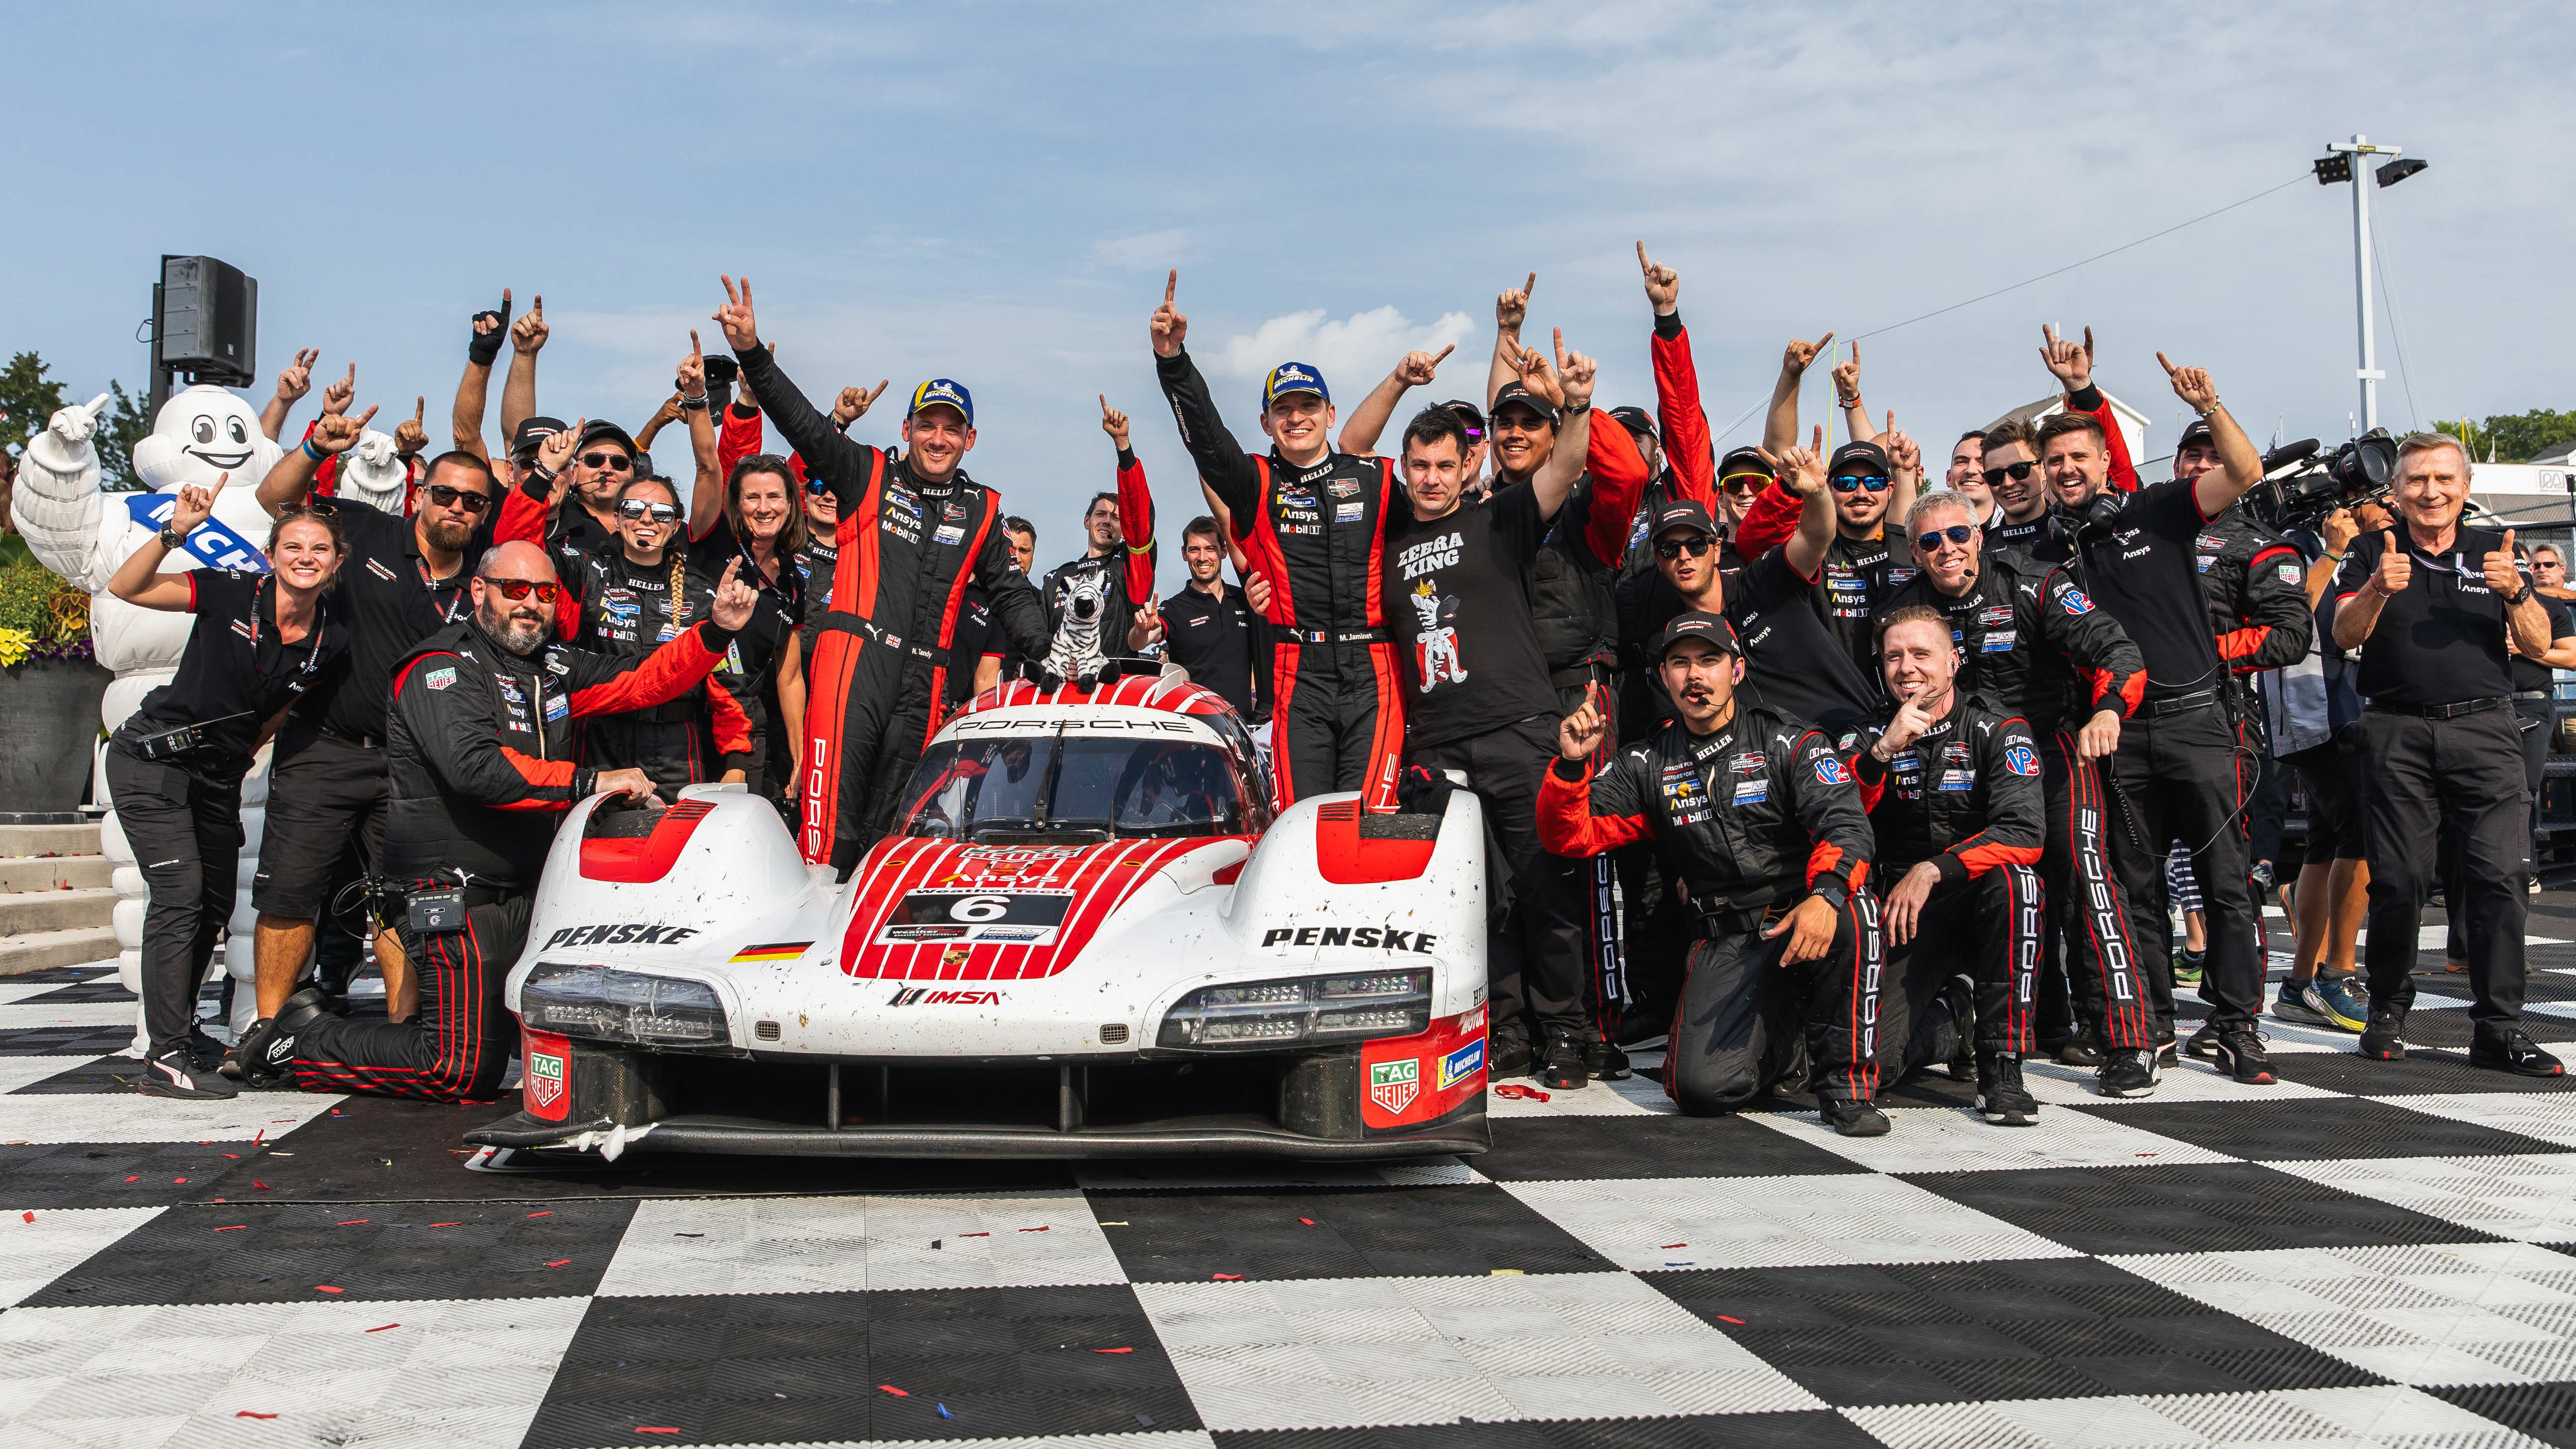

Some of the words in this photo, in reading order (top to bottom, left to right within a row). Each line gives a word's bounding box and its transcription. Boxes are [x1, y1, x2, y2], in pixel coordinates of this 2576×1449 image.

[1274, 376, 1314, 389] MICHELIN
[924, 392, 963, 404] MICHELIN
[1301, 463, 1333, 484] HELLER
[885, 506, 922, 530] Ansys
[1281, 508, 1319, 522] Ansys
[1663, 509, 1679, 517] PORSCHE
[1663, 513, 1687, 522] MOTORSPORT
[882, 520, 909, 539] Mobil
[1280, 523, 1308, 534] Mobil
[1309, 525, 1319, 535] 1
[2002, 526, 2036, 537] HELLER
[1397, 532, 1464, 568] ZEBRA
[2123, 545, 2150, 560] Ansys
[1404, 549, 1459, 581] KING
[1857, 551, 1889, 566] HELLER
[628, 578, 665, 591] HELLER
[2462, 585, 2489, 594] Ansys
[1832, 592, 1866, 605] Ansys
[1949, 594, 1984, 611] HELLER
[2061, 591, 2087, 614] VP
[971, 614, 986, 626] Ansys
[1742, 611, 1758, 627] BOSS
[1833, 608, 1857, 617] Mobil
[1858, 608, 1868, 617] 1
[598, 627, 625, 639] Mobil
[1749, 626, 1771, 647] Ansys
[732, 648, 737, 659] 6
[918, 648, 932, 659] Tandy
[428, 669, 452, 680] TAG
[549, 665, 562, 673] PUMA
[429, 677, 455, 688] HEUER
[509, 720, 527, 733] Mobil
[953, 719, 1194, 735] PORSCHE
[1696, 734, 1733, 761] HELLER
[2005, 747, 2032, 775] VP
[1663, 772, 1695, 781] MOTORSPORT
[1814, 758, 1840, 784] VP
[1670, 794, 1708, 811] Ansys
[1672, 811, 1702, 826] Mobil
[1703, 809, 1712, 820] 1
[149, 859, 180, 868] PORSCHE
[939, 873, 1060, 884] Ansys
[950, 895, 1011, 922] 6
[2081, 807, 2133, 1000] PORSCHE
[543, 924, 703, 952] PENSKE
[1261, 927, 1437, 954] PENSKE
[923, 991, 999, 1005] IMSA
[1461, 1009, 1484, 1036] MOTUL
[273, 1038, 294, 1058] sparco
[533, 1056, 559, 1076] TAG
[1454, 1050, 1481, 1074] MICHELIN
[1376, 1063, 1415, 1083] TAG
[532, 1076, 560, 1102] HEUER
[1375, 1082, 1416, 1110] HEUER
